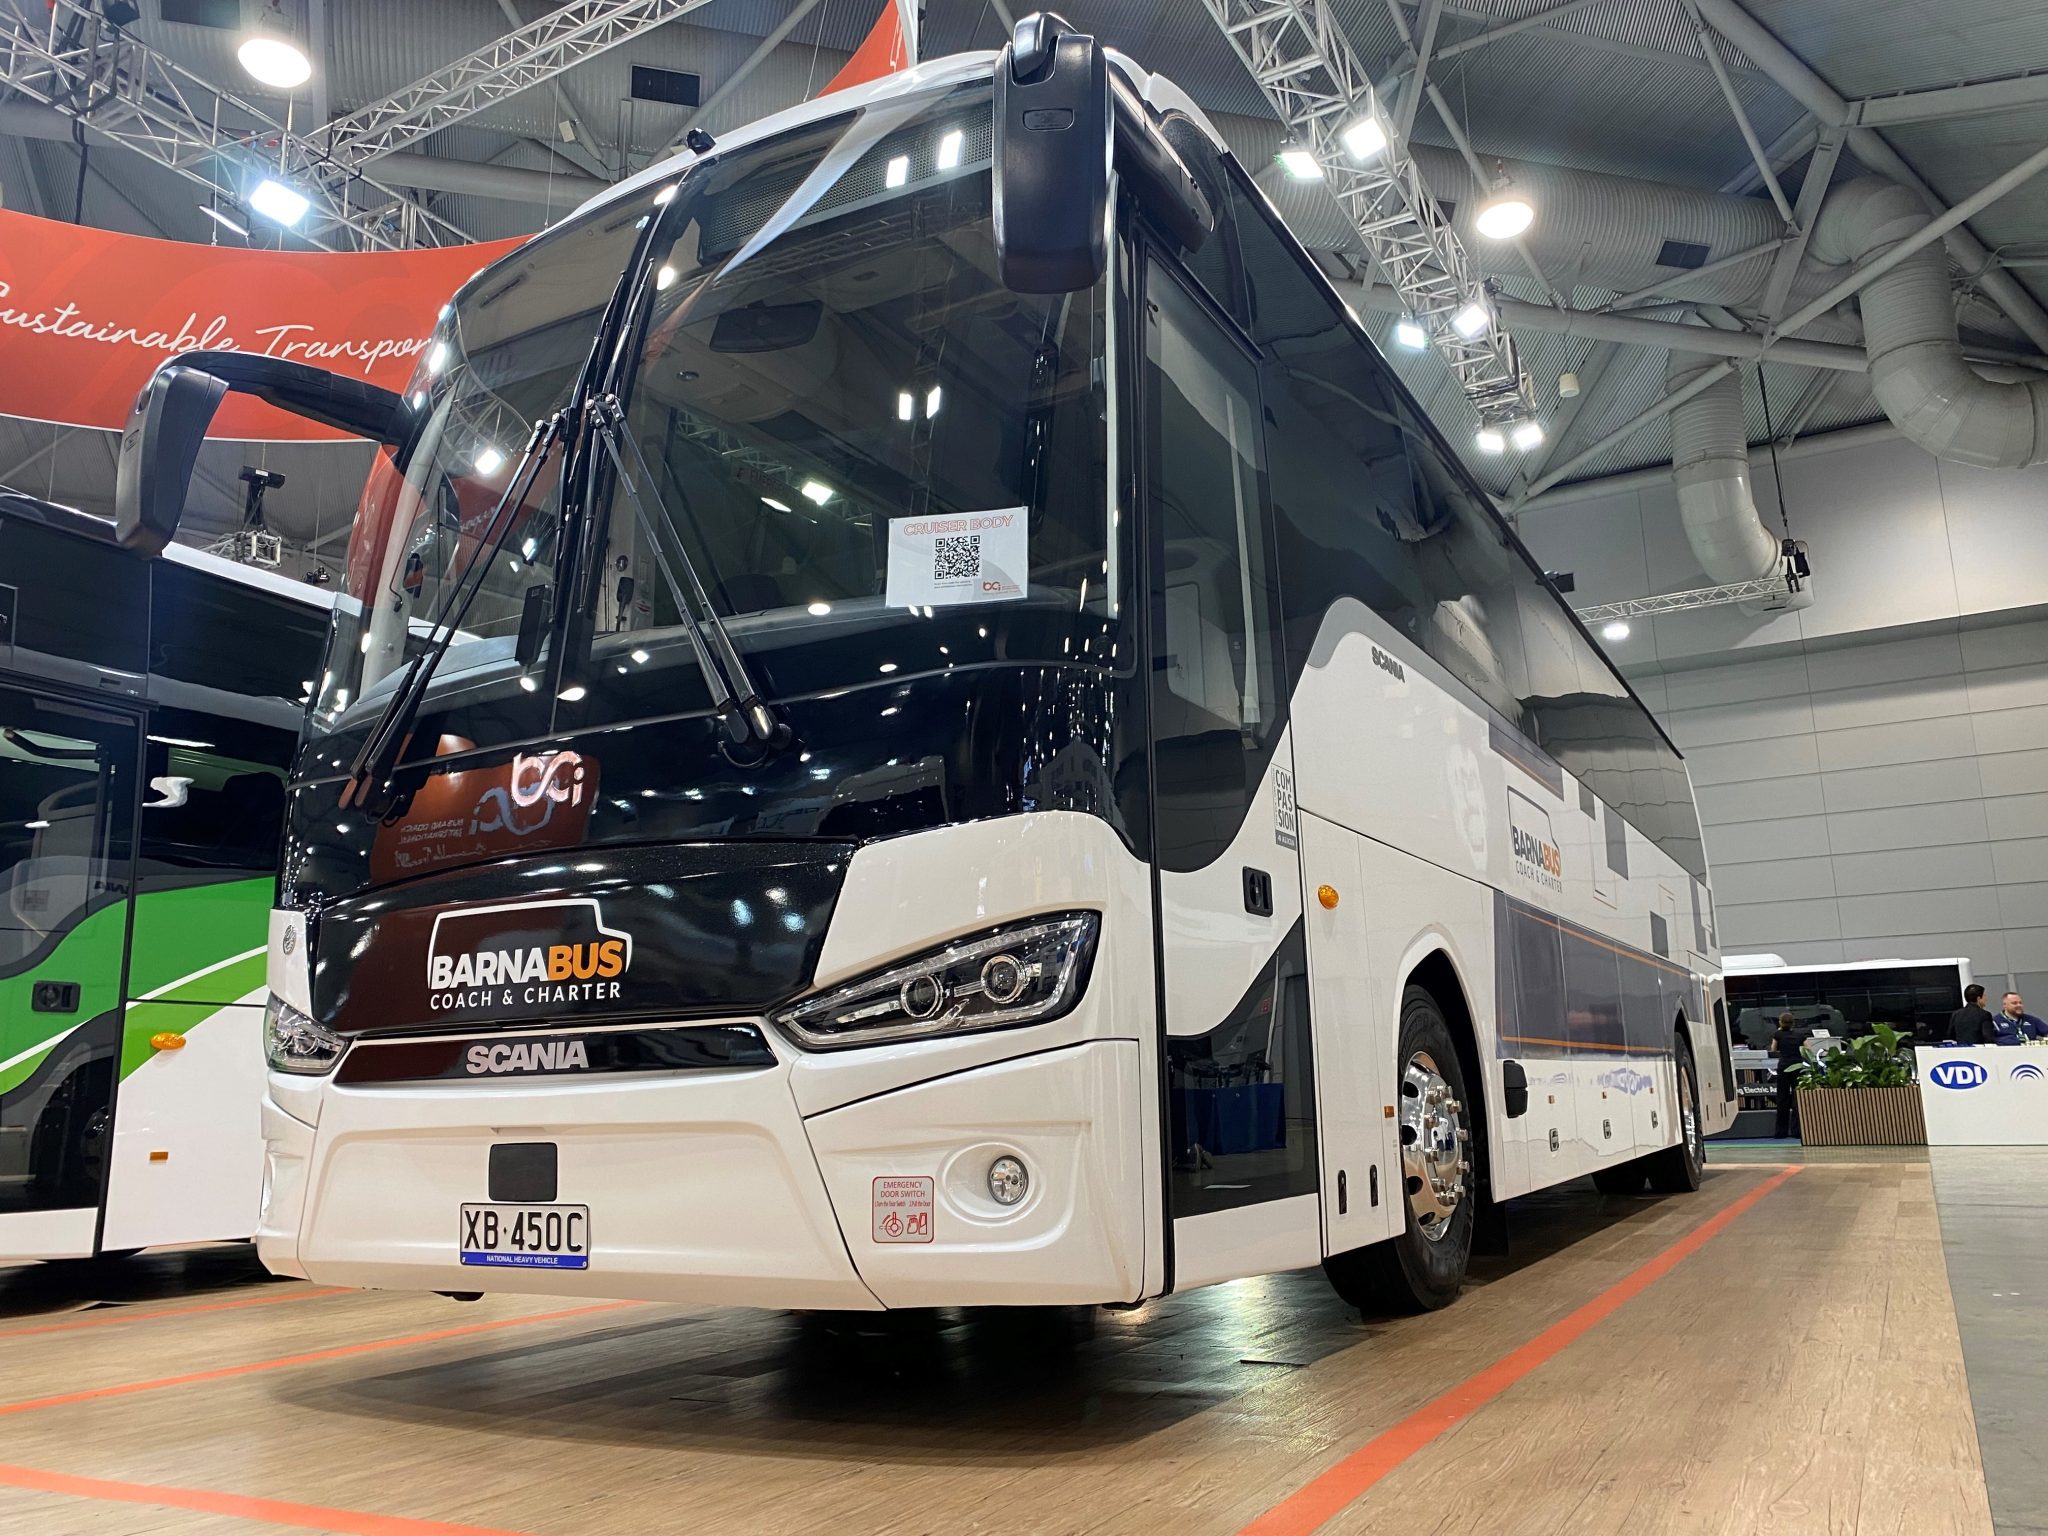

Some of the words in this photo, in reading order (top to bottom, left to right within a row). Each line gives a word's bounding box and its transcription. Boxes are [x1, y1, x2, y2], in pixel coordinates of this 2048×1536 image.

[903, 519, 968, 537] CRUISER
[969, 514, 1015, 531] BODY
[1371, 646, 1406, 684] SCANIA
[1275, 769, 1292, 793] COM
[1276, 788, 1293, 813] PAS
[1278, 808, 1295, 833] SION
[1511, 825, 1561, 878] BARNABUS
[1515, 860, 1535, 881] COACH
[1541, 873, 1563, 894] CHARTER
[430, 940, 624, 990] BARNABUS
[430, 990, 492, 1010] COACH
[502, 989, 514, 1005] &
[524, 982, 621, 1004] CHARTER
[466, 1040, 590, 1075] SCANIA
[1935, 1065, 1984, 1085] VDI
[883, 1181, 923, 1189] EMERGENCY
[900, 1190, 925, 1198] SWITCH
[486, 1255, 514, 1264] NATIONAL
[513, 1256, 534, 1264] HEAVY
[534, 1256, 558, 1265] VEHICLE
